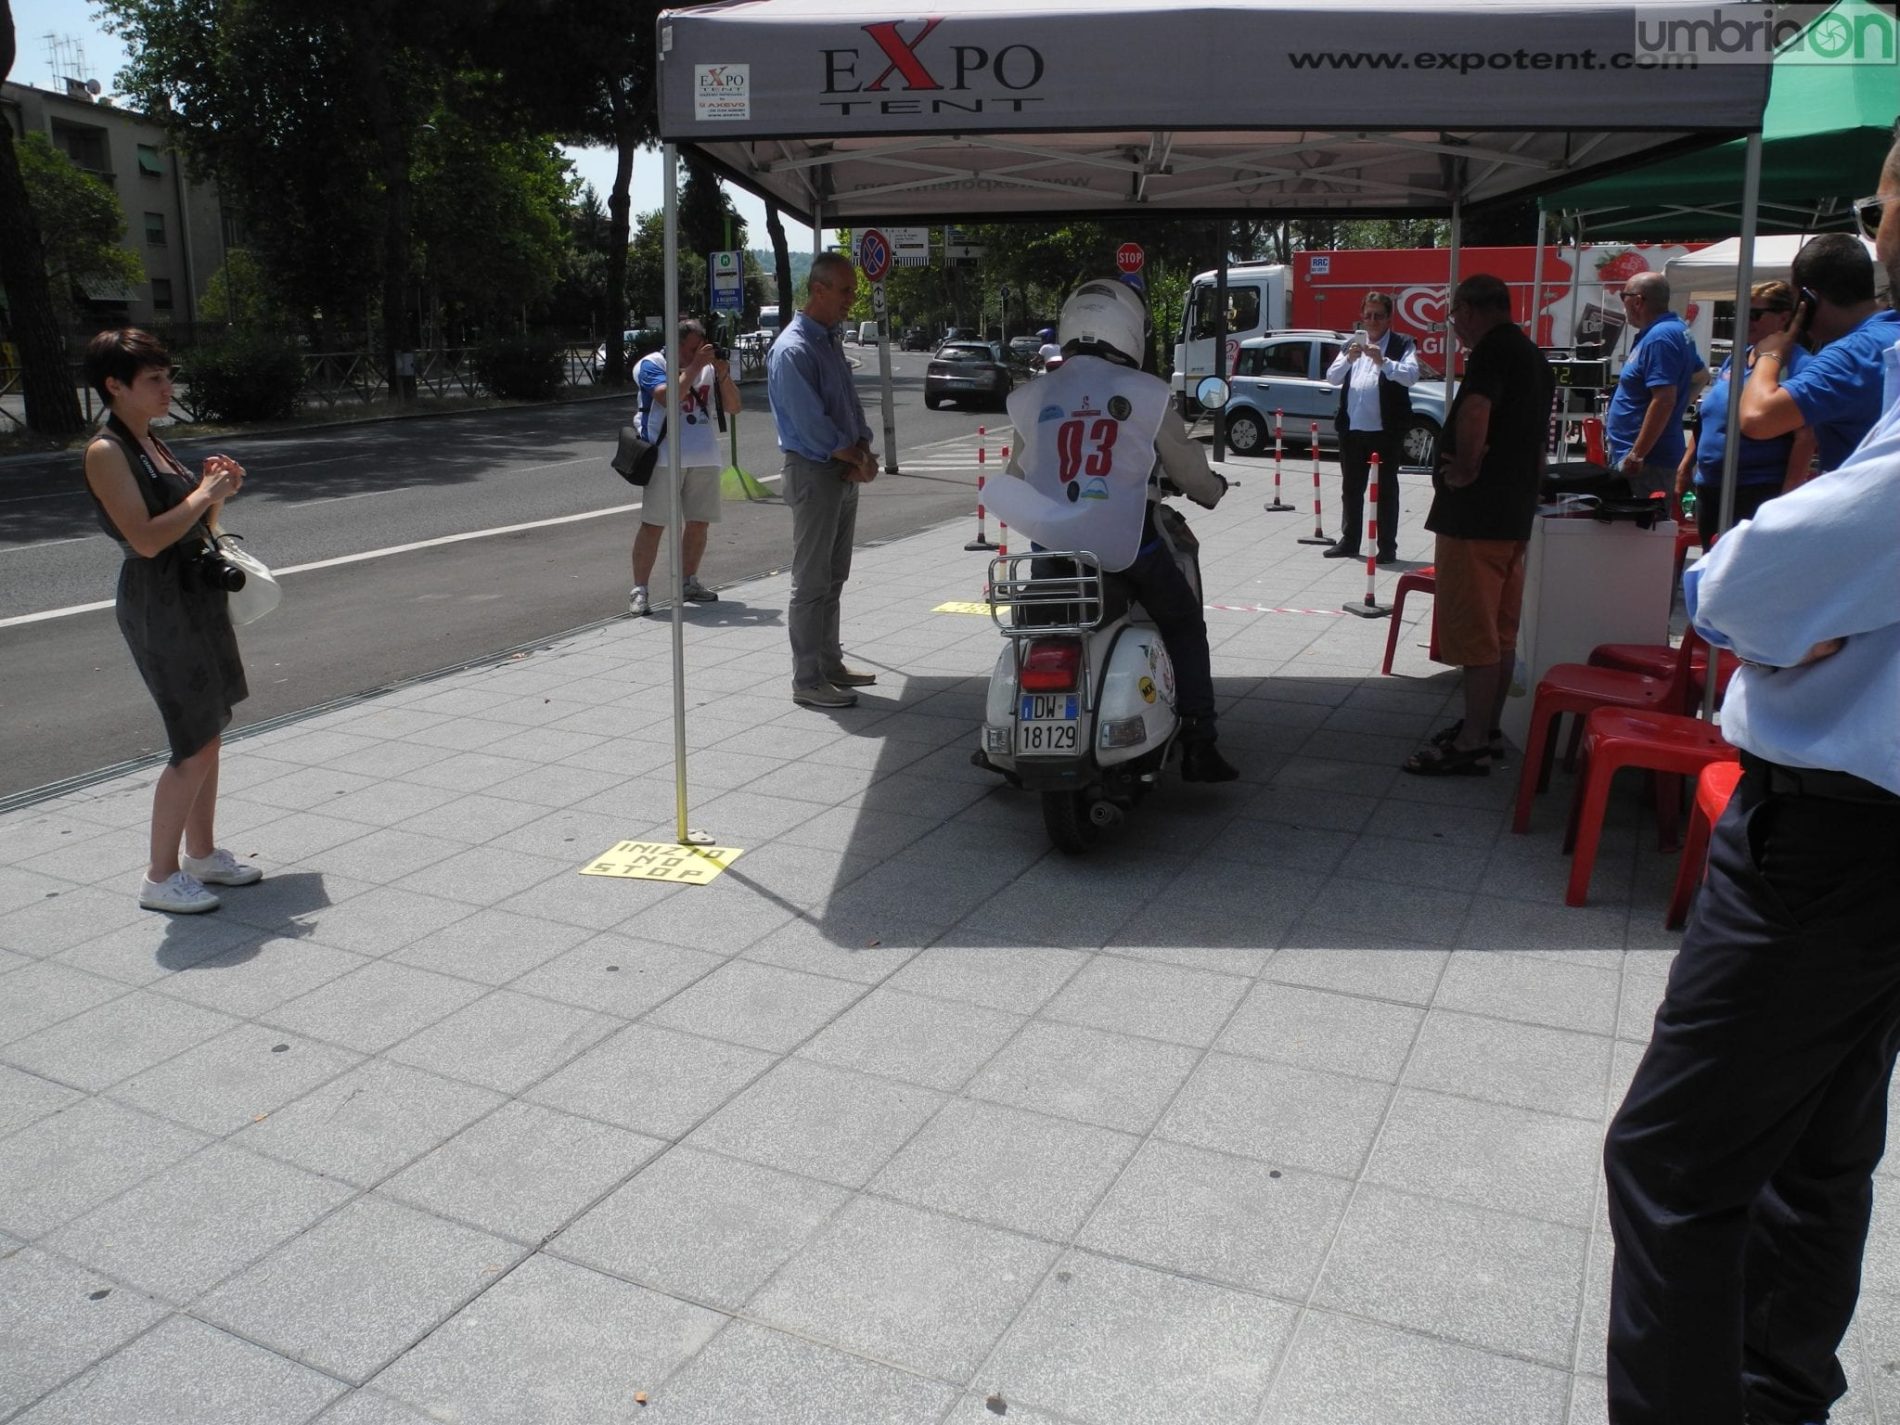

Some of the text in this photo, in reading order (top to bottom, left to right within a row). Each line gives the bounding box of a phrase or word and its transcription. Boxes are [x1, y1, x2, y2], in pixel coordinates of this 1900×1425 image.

[818, 16, 1044, 94] EXPO
[1288, 51, 1699, 75] www.expotent.com
[700, 66, 744, 87] EXPO
[819, 98, 1044, 116] TENT
[1119, 252, 1142, 264] STOP
[1057, 419, 1119, 484] 03
[1034, 695, 1056, 718] DW
[1023, 726, 1076, 749] 18129
[590, 862, 703, 879] STOP
[632, 855, 684, 867] NO
